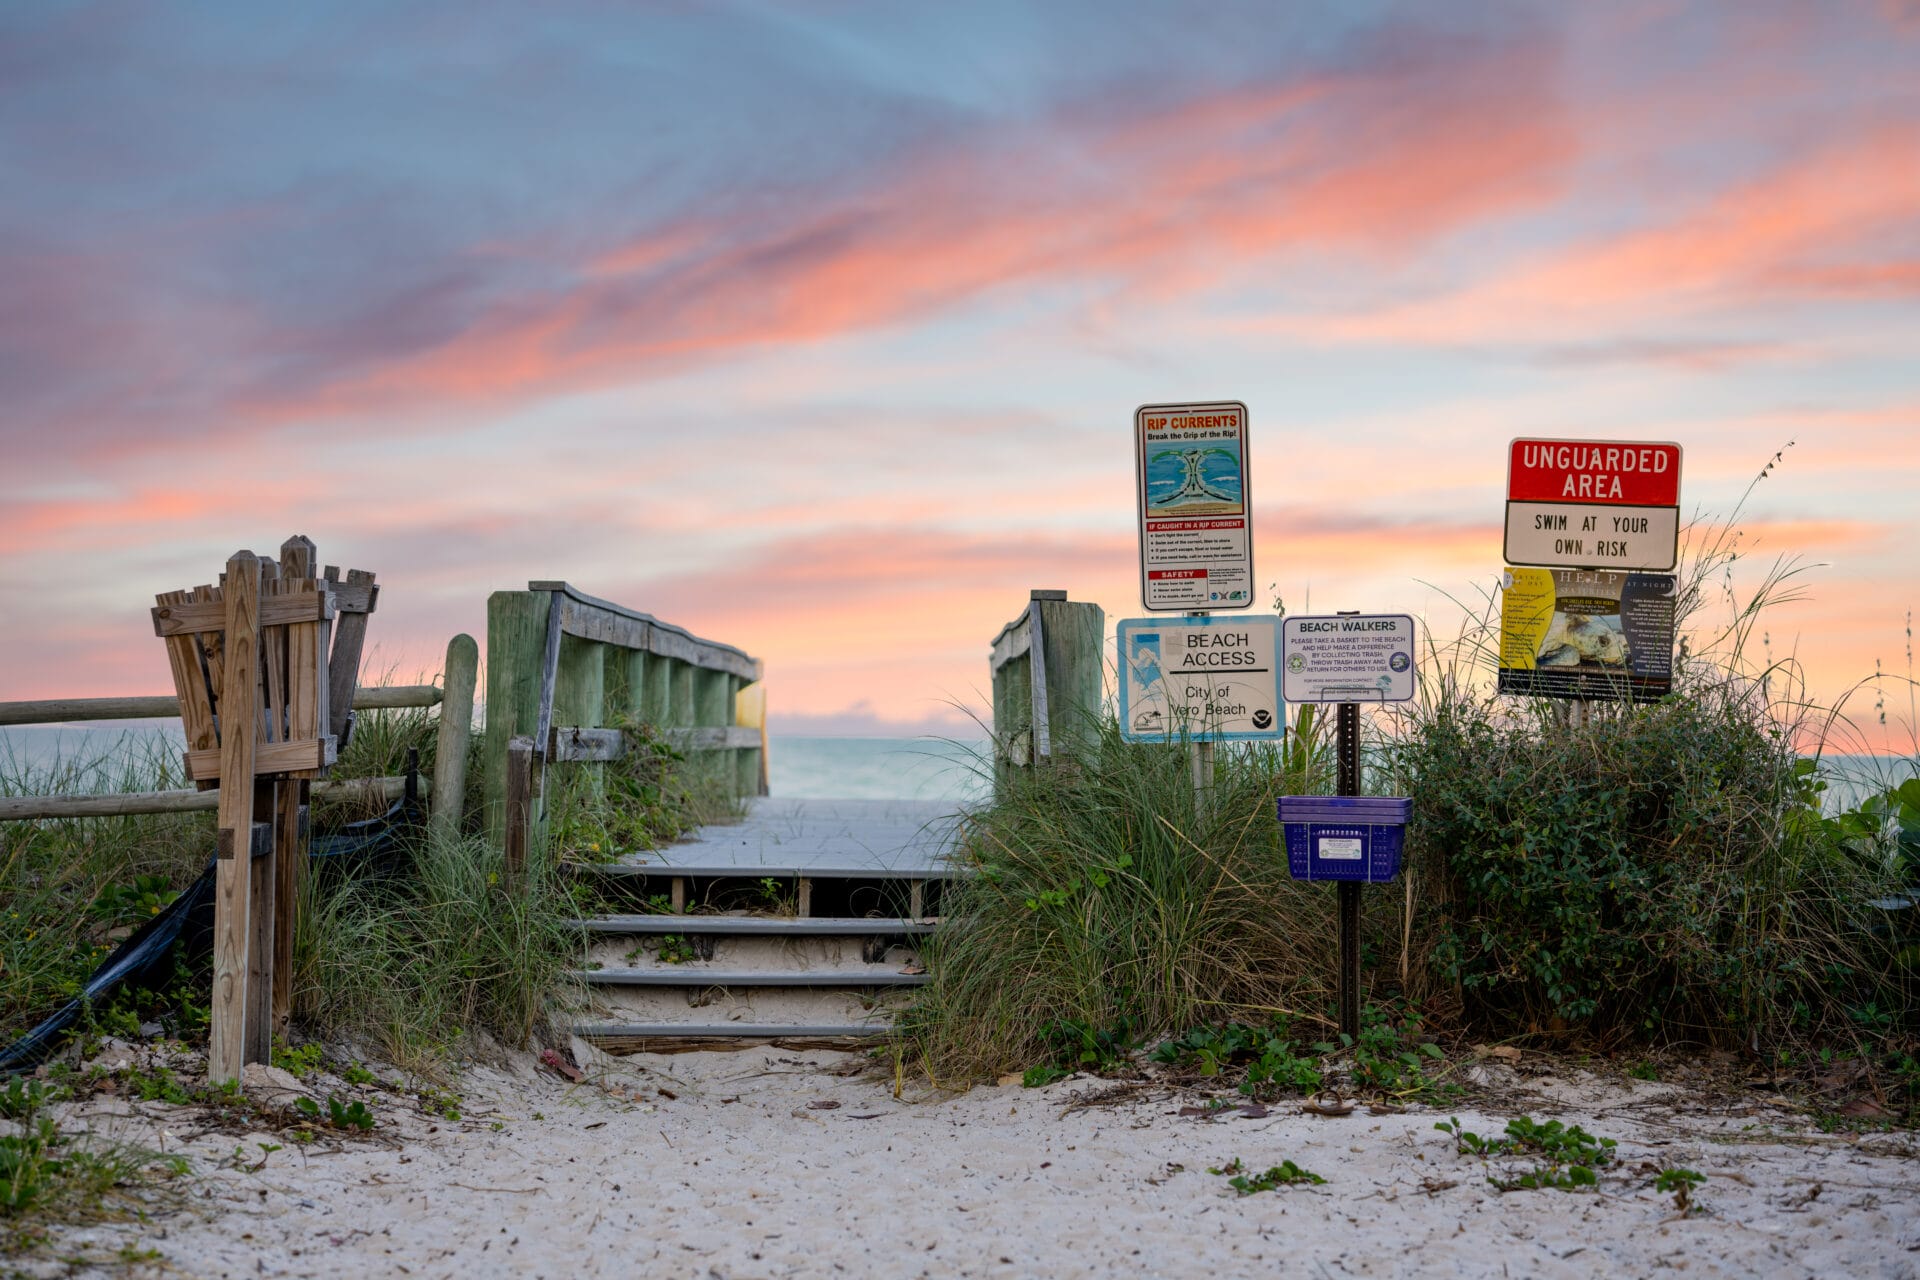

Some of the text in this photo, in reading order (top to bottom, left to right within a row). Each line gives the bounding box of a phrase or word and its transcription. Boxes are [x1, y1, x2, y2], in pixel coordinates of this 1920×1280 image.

[1148, 415, 1236, 430] RIP CURRENTS
[1524, 446, 1667, 473] UNGUARDED
[1562, 474, 1623, 498] AREA
[1535, 515, 1648, 533] SWIM AT YOUR
[1556, 539, 1627, 557] OWN RISK
[1561, 572, 1617, 584] HELP
[1300, 622, 1396, 632] BEACH WALKERS
[1188, 633, 1248, 648] BEACH
[1183, 652, 1255, 666] ACCESS
[1186, 686, 1230, 700] City of
[1171, 703, 1246, 715] Vero Beach
